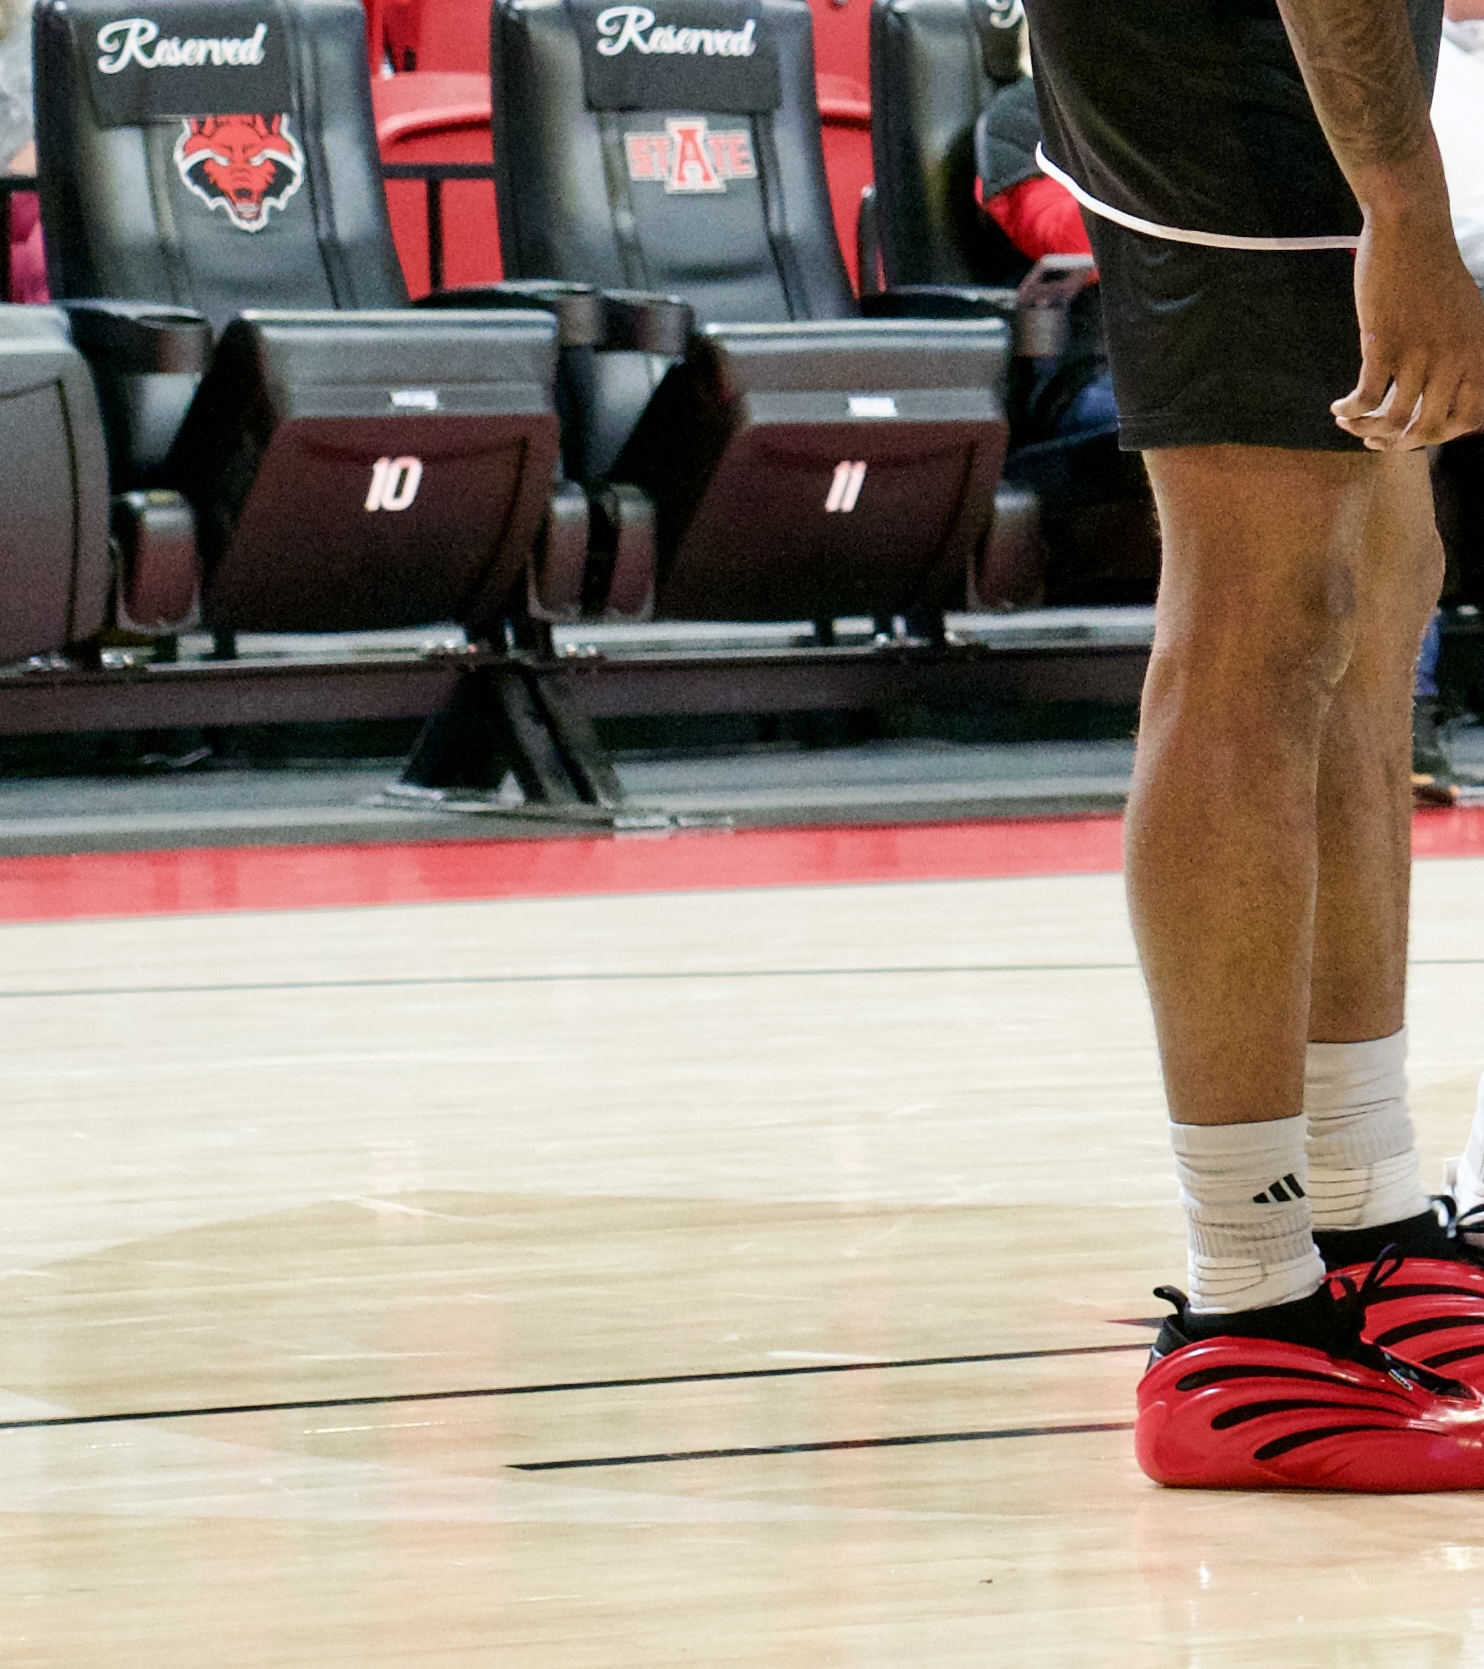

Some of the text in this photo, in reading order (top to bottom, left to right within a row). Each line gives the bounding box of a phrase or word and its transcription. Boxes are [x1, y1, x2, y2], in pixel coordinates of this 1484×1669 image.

[97, 18, 268, 74] Reserved
[596, 5, 757, 57] Reserved
[624, 117, 758, 195] STATE
[364, 456, 424, 512] 10
[824, 459, 867, 513] 11
